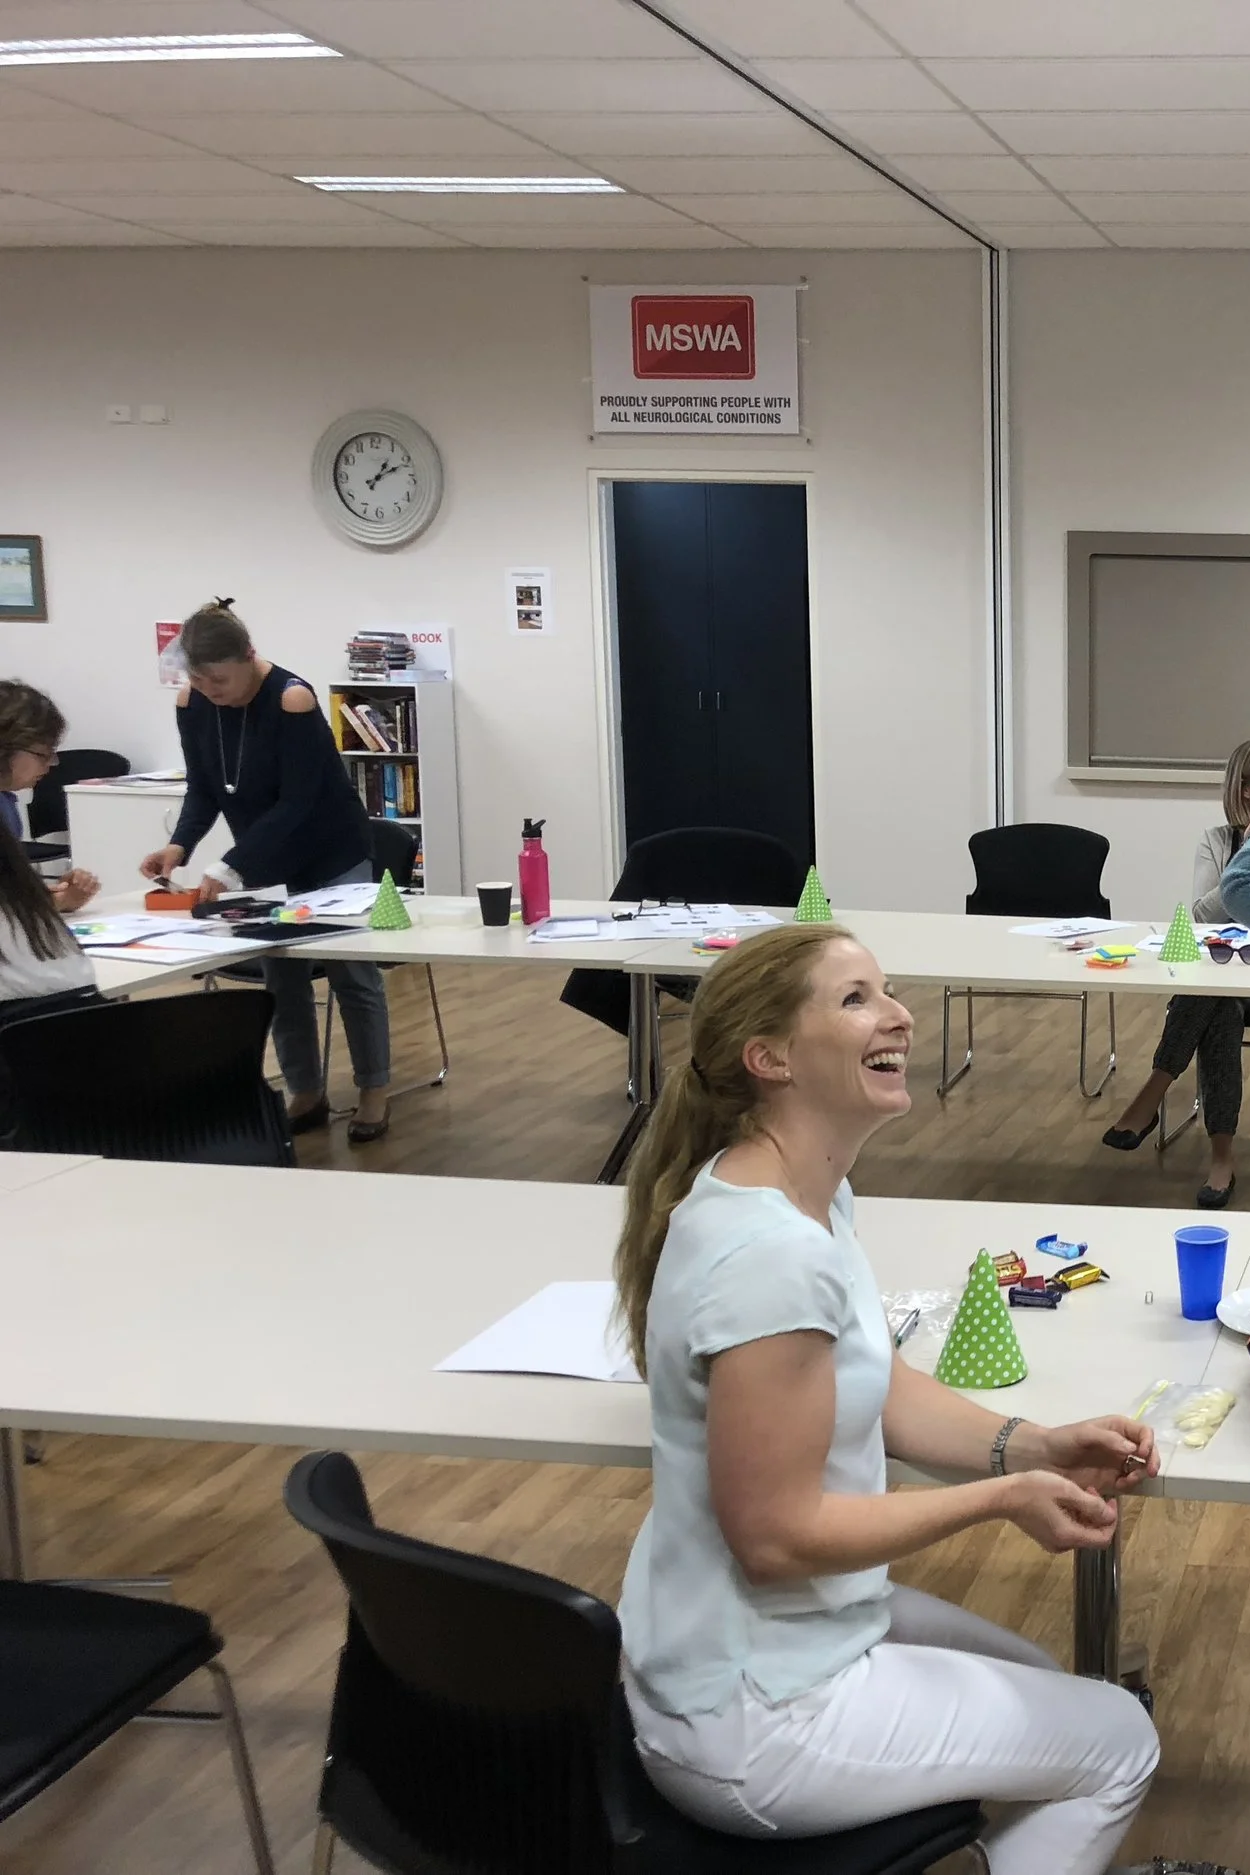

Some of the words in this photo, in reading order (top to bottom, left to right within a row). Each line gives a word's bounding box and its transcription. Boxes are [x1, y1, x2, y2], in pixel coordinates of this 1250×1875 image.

[645, 323, 742, 352] MSWA
[600, 395, 648, 408] PROUDLY
[651, 396, 718, 408] SUPPORTING
[721, 396, 761, 409] PEOPLE
[763, 397, 791, 409] WITH
[610, 411, 631, 423] ALL
[633, 411, 714, 424] NEUROLOGICAL
[716, 412, 782, 425] CONDITIONS
[411, 633, 442, 643] BOOK
